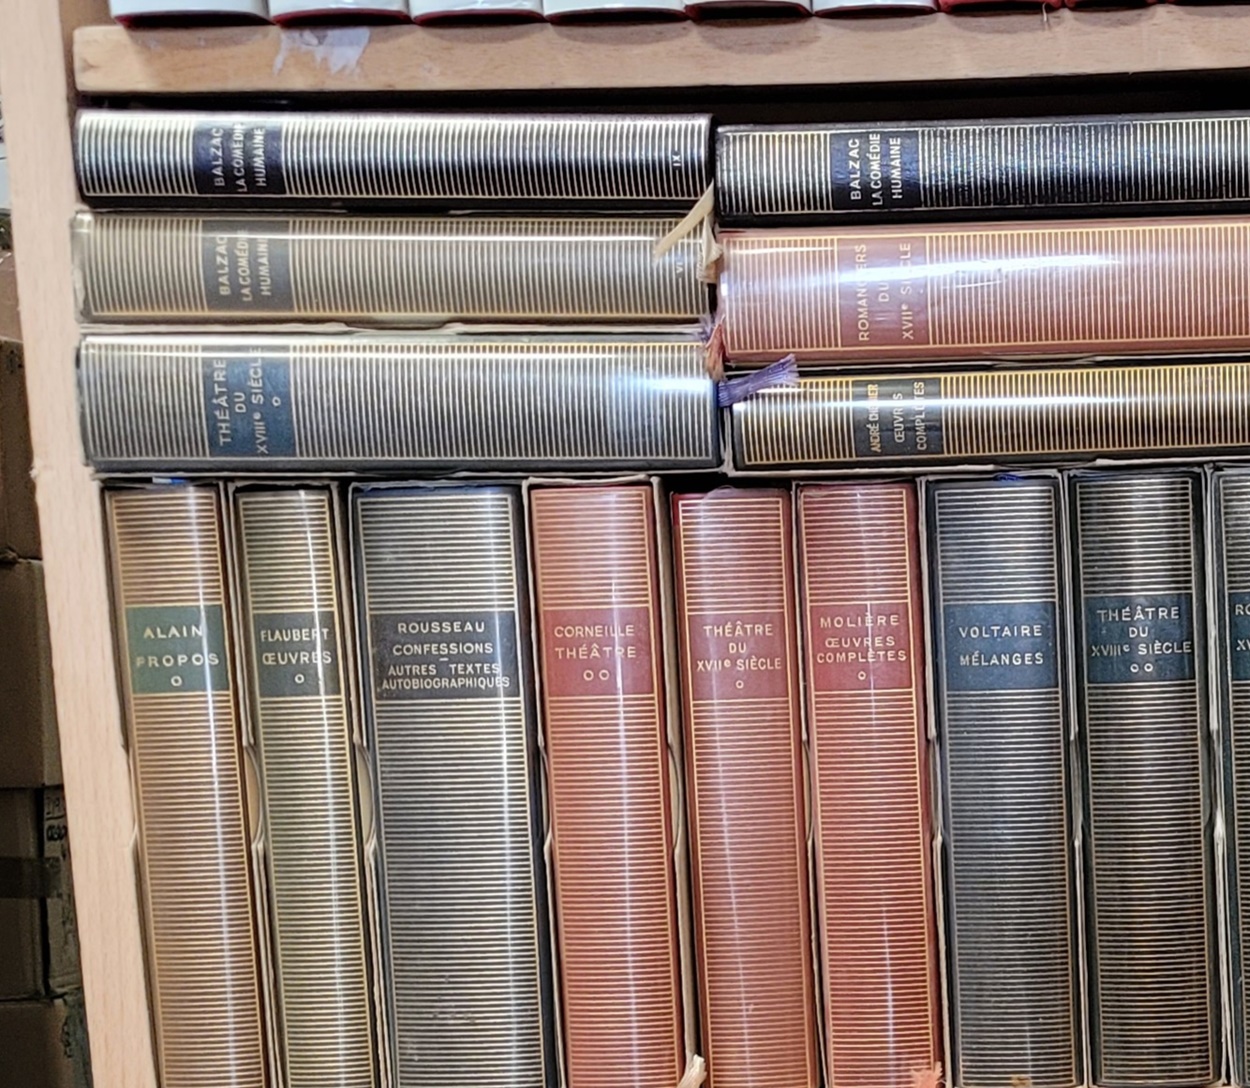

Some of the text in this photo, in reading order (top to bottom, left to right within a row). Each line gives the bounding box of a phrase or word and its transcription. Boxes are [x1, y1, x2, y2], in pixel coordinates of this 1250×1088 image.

[211, 127, 225, 187] BALZAC
[253, 127, 267, 187] HUMAINE
[848, 138, 862, 200] BALZAC
[866, 133, 883, 206] LA COMÉDIE
[889, 137, 903, 199] HUMAINE
[211, 358, 232, 446] THÉÂTRE
[234, 391, 247, 413] DU
[820, 612, 900, 628] MOLIÈRE
[1097, 606, 1180, 622] THÉÂTRE
[143, 625, 203, 639] ALAIN
[398, 621, 485, 634] ROUSSEAU
[554, 624, 635, 638] CORNEILLE
[703, 621, 774, 637] THÉÂTRE
[959, 624, 1043, 638] VOLTAIRE
[1129, 626, 1149, 639] DU
[729, 642, 747, 654] DU
[825, 635, 896, 648] ŒUVRES
[1138, 640, 1192, 655] SIÈCLE
[392, 643, 494, 656] CONFESSIONS
[555, 643, 637, 659] THÉÂTRE
[816, 648, 907, 664] COMPLÈTES
[136, 653, 220, 667] PROPOS
[262, 651, 332, 665] ŒUVRES
[736, 655, 782, 671] SIÈCLE
[959, 651, 1044, 666] MÉLANGES
[388, 663, 501, 676] AUTRES TEXTES
[382, 676, 510, 690] AUTOBIOGRAPHIQUES
